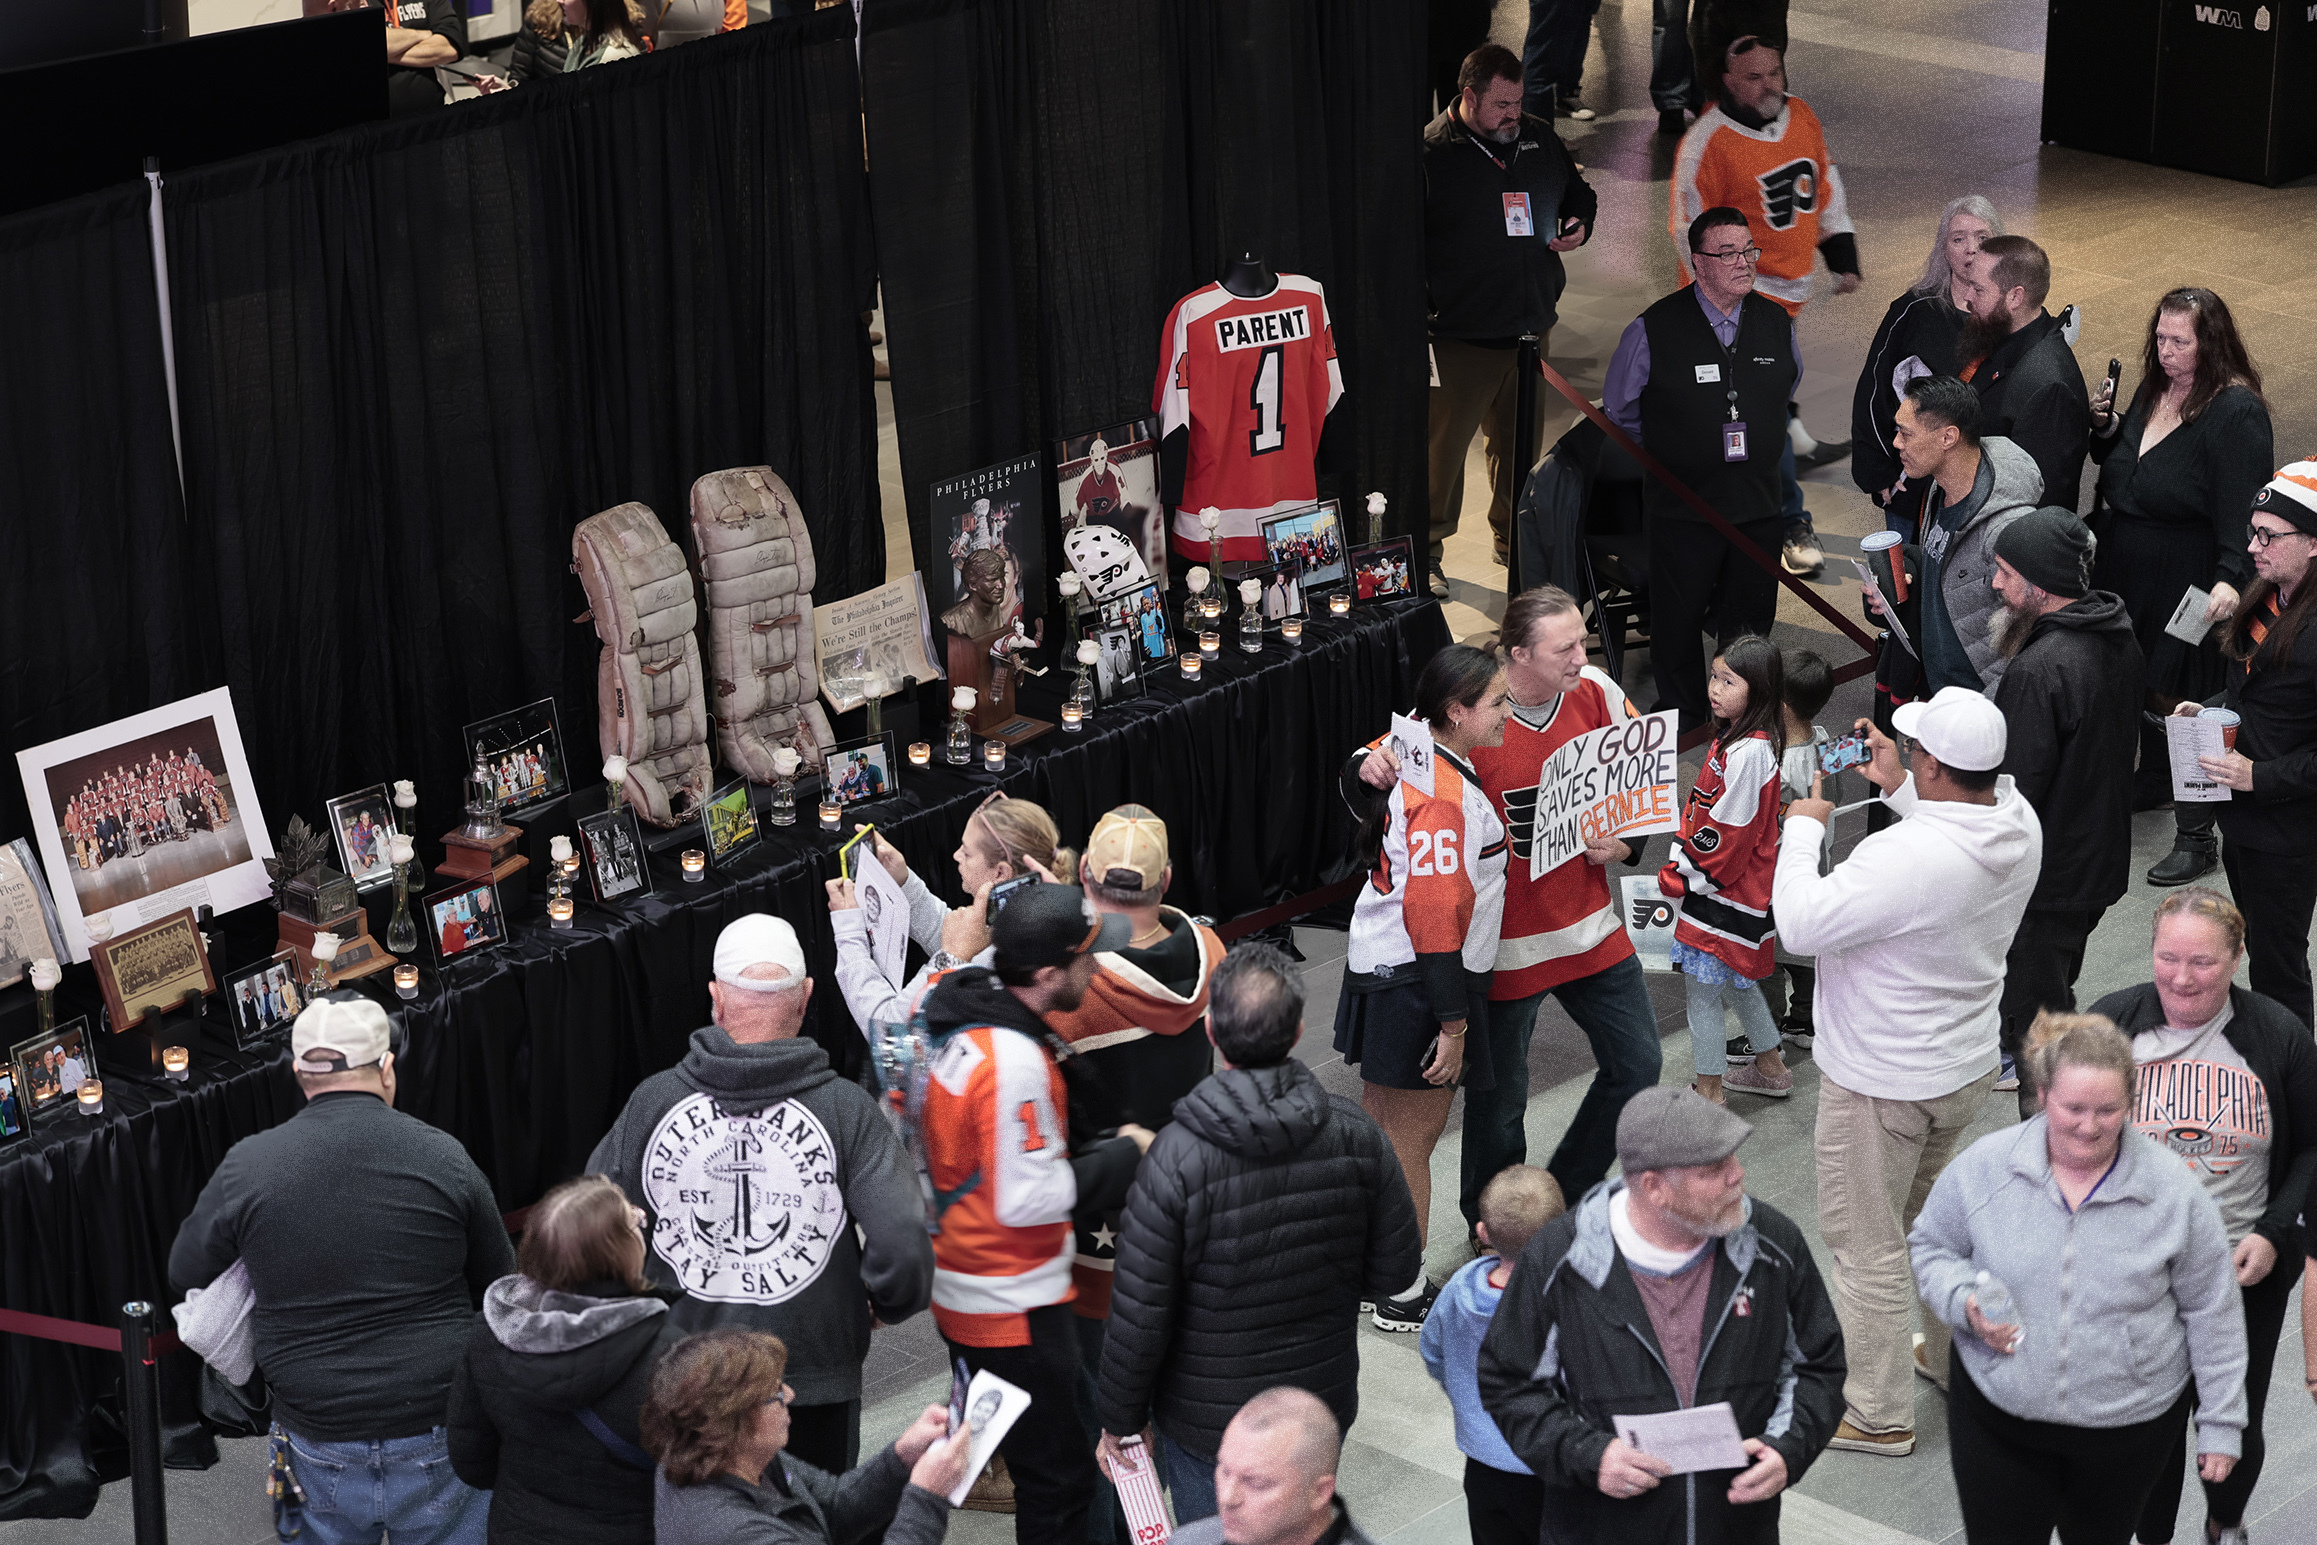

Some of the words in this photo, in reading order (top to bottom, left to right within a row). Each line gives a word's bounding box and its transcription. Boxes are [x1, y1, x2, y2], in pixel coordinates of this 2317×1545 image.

[397, 2, 427, 22] FLYERS
[2194, 4, 2243, 29] WM
[1219, 310, 1305, 348] PARENT
[1249, 344, 1286, 458] 1
[937, 459, 1036, 497] PHILADELPHIA
[963, 477, 1011, 500] FLYERS
[821, 634, 846, 648] We're
[848, 625, 866, 640] Still
[869, 623, 882, 634] the
[884, 606, 918, 628] Champs!
[831, 615, 844, 626] The
[846, 603, 881, 623] Philadelphia
[882, 595, 904, 610] Inquirer
[1540, 735, 1589, 794] ONLY
[1597, 716, 1667, 766] GOD
[1537, 768, 1597, 832] SAVES
[1604, 749, 1677, 797] MORE
[1536, 813, 1579, 874] THAN
[1580, 784, 1672, 842] BERNIE
[1409, 829, 1459, 877] 26
[1016, 1100, 1047, 1152] 1
[2220, 1135, 2238, 1154] 75
[666, 1126, 715, 1184] NORTH
[727, 1120, 813, 1189] CAROLINA
[679, 1189, 714, 1205] EST.
[653, 1217, 719, 1290] STAY
[742, 1224, 828, 1295] SALTY
[1137, 1523, 1165, 1542] POP
